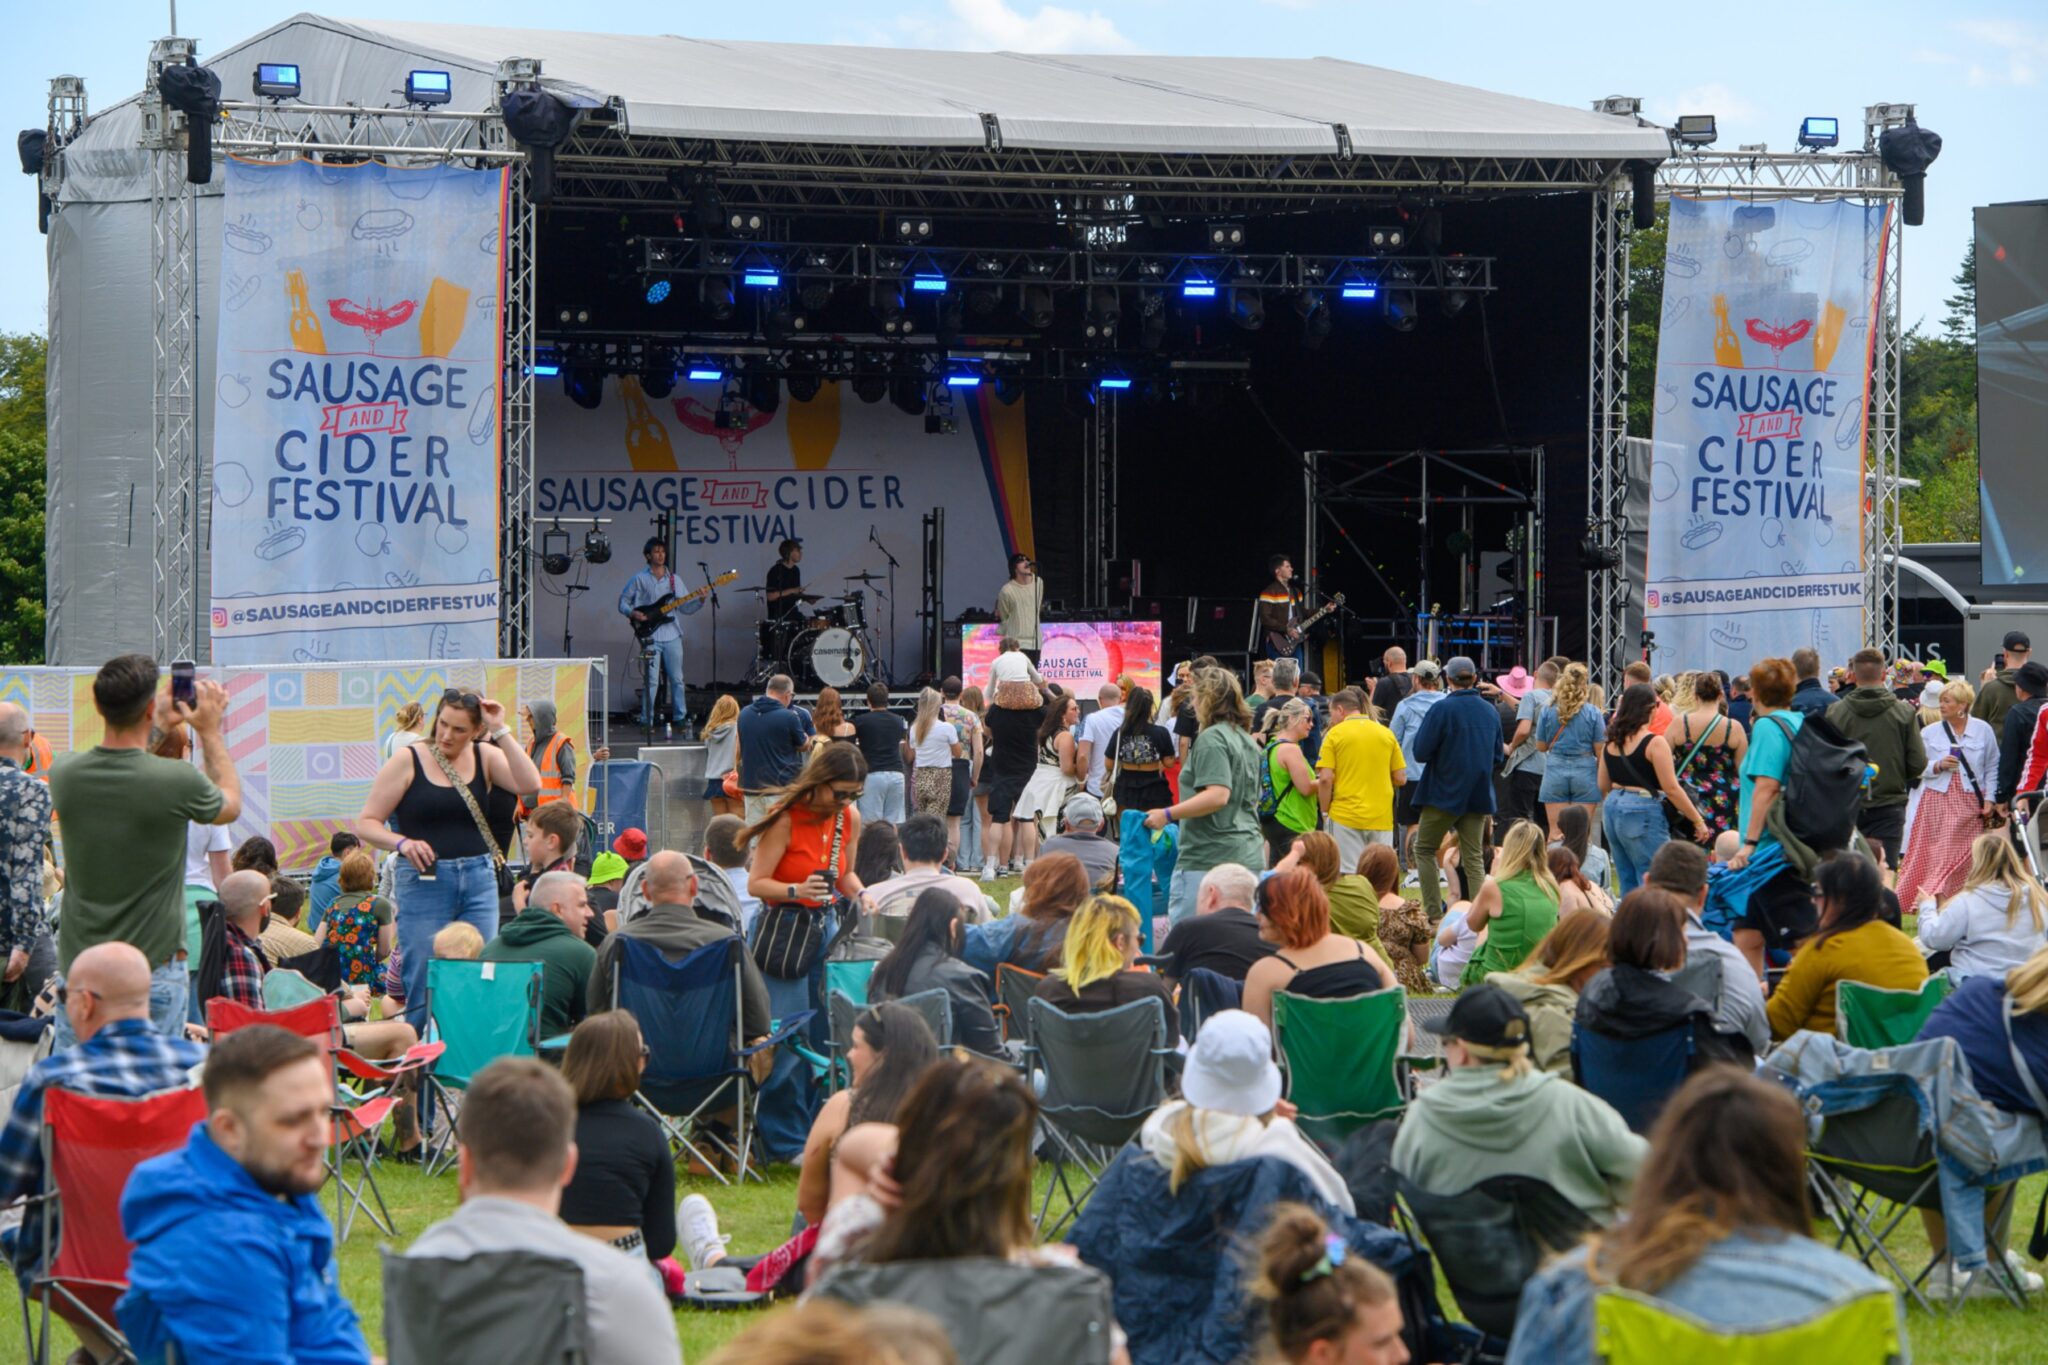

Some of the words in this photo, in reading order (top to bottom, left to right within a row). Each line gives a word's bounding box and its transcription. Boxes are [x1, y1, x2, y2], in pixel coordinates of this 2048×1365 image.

[266, 358, 468, 409] SAUSAGE
[1691, 371, 1838, 418] SAUSAGE
[349, 409, 384, 427] AND
[1758, 416, 1783, 433] AND
[275, 430, 451, 479] CIDER
[1698, 435, 1823, 479] CIDER
[267, 477, 468, 526] FESTIVAL
[538, 476, 700, 512] SAUSAGE
[721, 487, 750, 500] AND
[774, 475, 905, 511] CIDER
[1691, 476, 1833, 522] FESTIVAL
[231, 593, 497, 624] @SAUSAGEANDCIDERFESTUK
[1661, 582, 1861, 605] @SAUSAGEANDCIDERFESTUK
[1066, 670, 1103, 678] FESTIVAL
